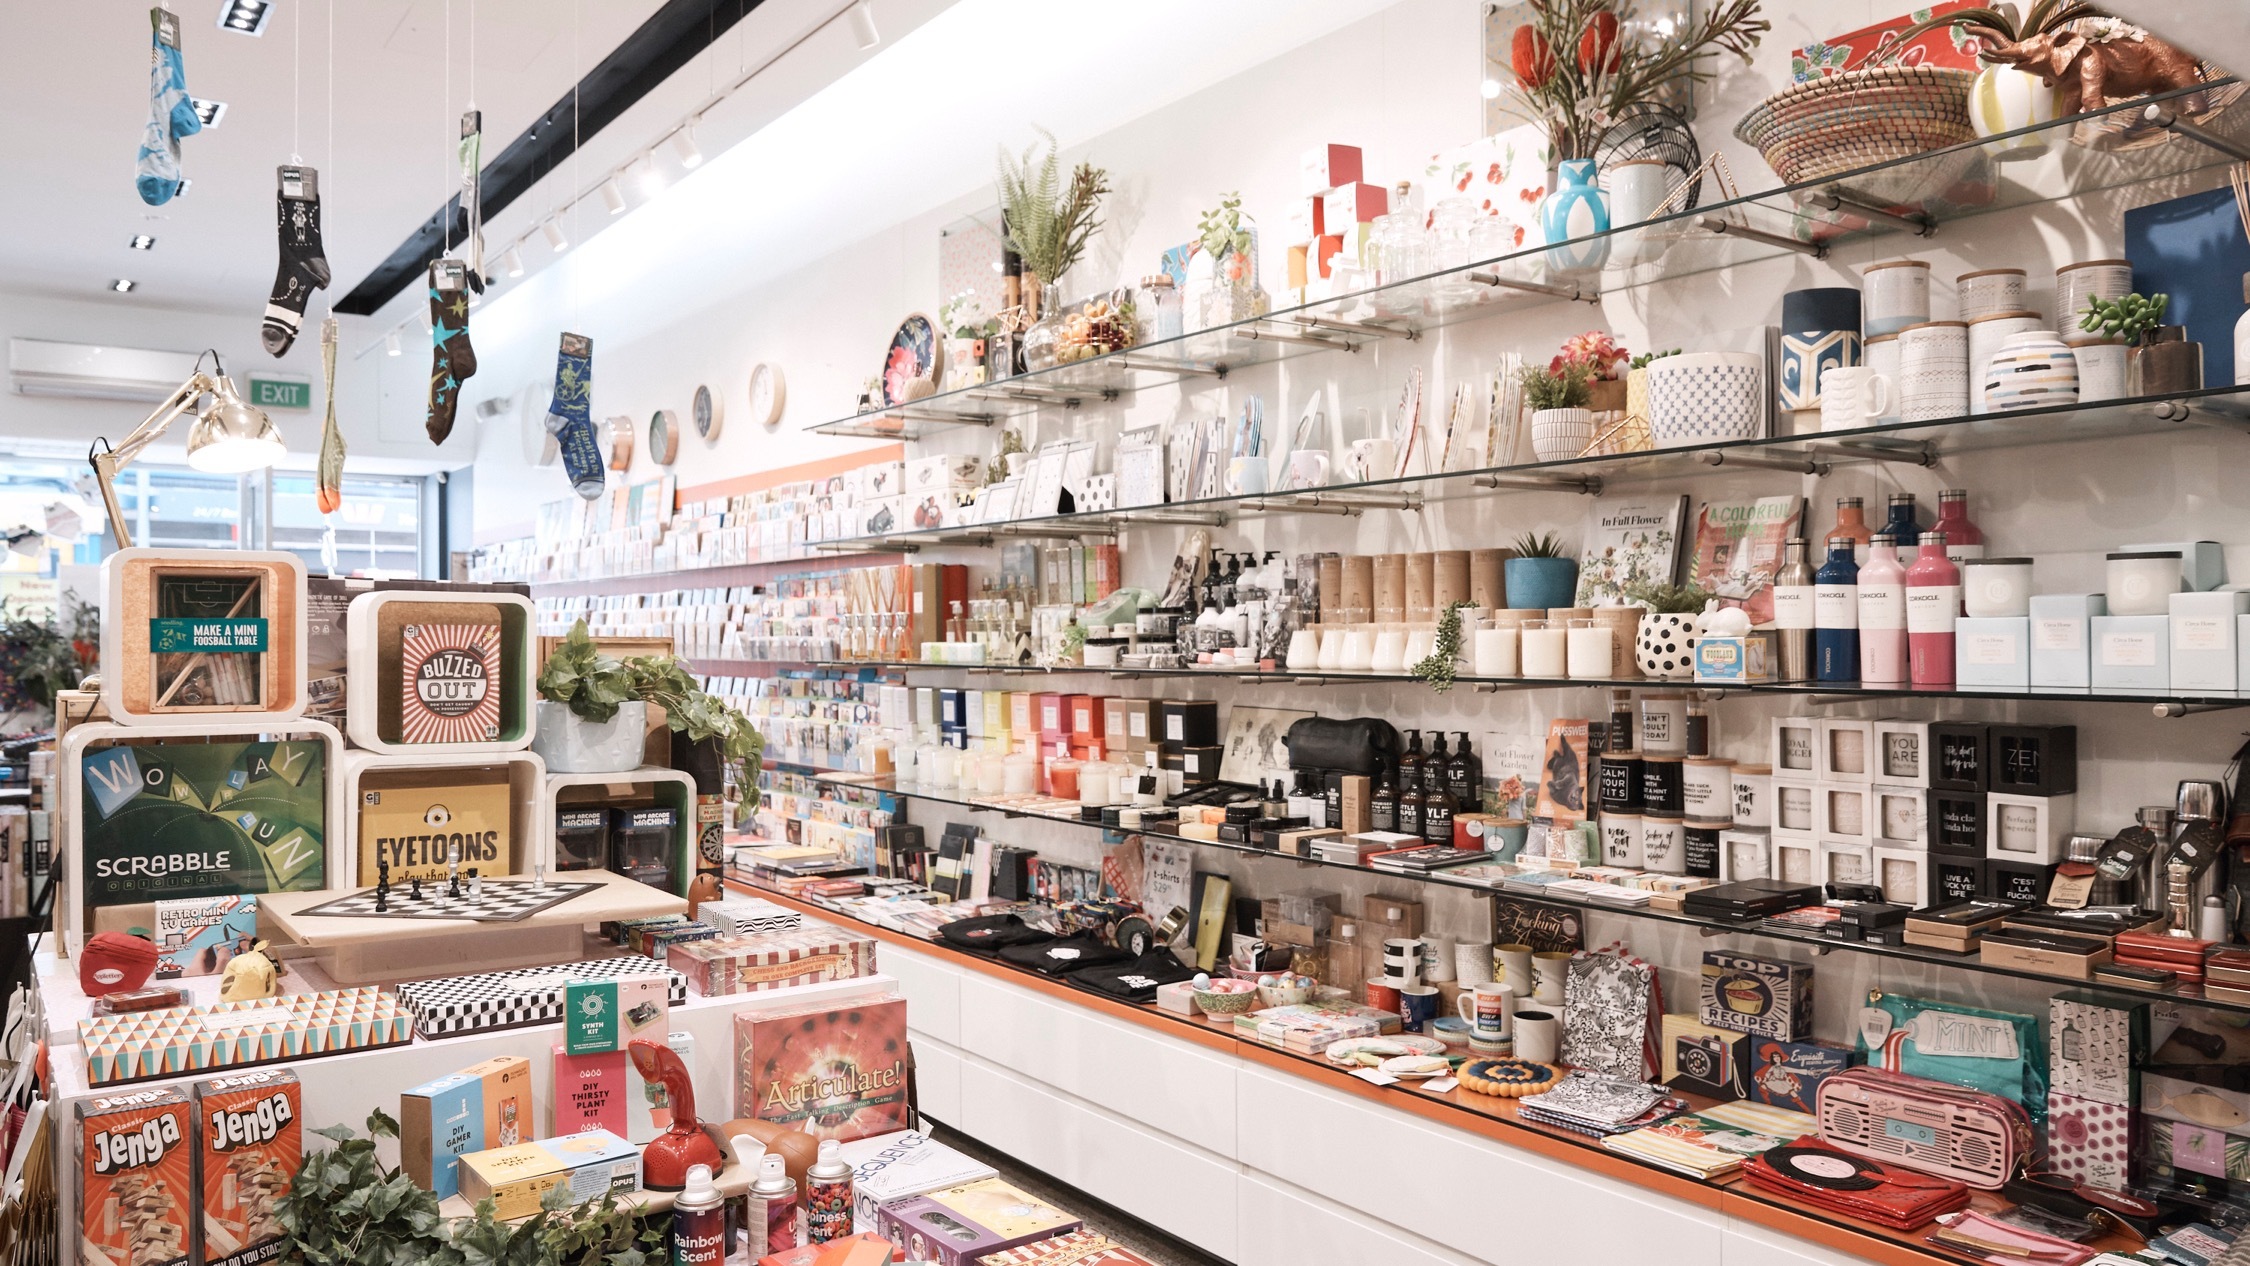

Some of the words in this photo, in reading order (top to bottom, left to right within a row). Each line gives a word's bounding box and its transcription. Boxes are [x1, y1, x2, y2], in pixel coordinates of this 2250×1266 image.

[261, 384, 299, 404] EXIT
[1709, 508, 1717, 522] A
[1720, 503, 1791, 522] COLORFUL
[1602, 517, 1611, 527] In
[1612, 516, 1631, 526] Full
[1631, 514, 1664, 525] Flower
[194, 625, 222, 637] MAKE
[225, 625, 231, 636] A
[234, 625, 258, 636] MINI
[194, 636, 233, 646] FOOSBALL
[235, 636, 258, 646] TABLE
[423, 654, 482, 678] BUZZED
[427, 682, 476, 698] OUT
[1892, 738, 1918, 748] YOU
[1494, 750, 1506, 758] Cut
[1509, 749, 1534, 760] Flower
[1892, 750, 1919, 762] ARE
[1501, 760, 1527, 769] Garden
[1602, 769, 1625, 777] CALM
[1427, 807, 1449, 819] YLF
[562, 819, 601, 827] MACHINE
[633, 818, 670, 826] MACHINE
[376, 831, 498, 868] EYETOONS
[96, 851, 231, 877] SCRABBLE
[2106, 858, 2128, 871] OPUS
[108, 875, 221, 891] ORIGINAL
[1154, 870, 1180, 884] t-shirts
[2013, 877, 2036, 886] C'EST
[2018, 885, 2030, 893] LA
[161, 908, 199, 920] RETRO
[202, 906, 229, 917] MINI
[161, 919, 178, 929] TV
[180, 917, 222, 928] GAMES
[1710, 954, 1781, 974] TOP
[1709, 1009, 1779, 1032] RECIPES
[1713, 1020, 1729, 1029] KEEP
[1730, 1024, 1750, 1034] UNDER
[1751, 1028, 1773, 1038] COVER
[1934, 1020, 2001, 1053] MINT
[1790, 1049, 1825, 1067] Exquisite
[212, 1068, 285, 1090] Jenga
[763, 1060, 901, 1112] Articulate!
[583, 1083, 599, 1091] DIY
[95, 1088, 172, 1110] Jenga
[572, 1090, 609, 1101] THIRSTY
[228, 1096, 259, 1111] Classic
[576, 1100, 606, 1109] PLANT
[786, 1113, 801, 1121] Fast
[805, 1107, 830, 1118] Talking
[833, 1099, 871, 1112] Description
[874, 1095, 893, 1105] Game
[584, 1109, 599, 1117] KIT
[111, 1116, 144, 1133] Classic
[212, 1091, 292, 1150] Jenga
[452, 1124, 465, 1136] DIY
[94, 1113, 180, 1172] Jenga
[446, 1131, 471, 1148] GAMER
[453, 1144, 465, 1154] KIT
[612, 1177, 634, 1187] OPUS
[809, 1225, 833, 1237] cent
[674, 1232, 723, 1249] Rainbow
[241, 1252, 259, 1265] YOU
[260, 1241, 282, 1259] STAC
[680, 1249, 717, 1262] Scent
